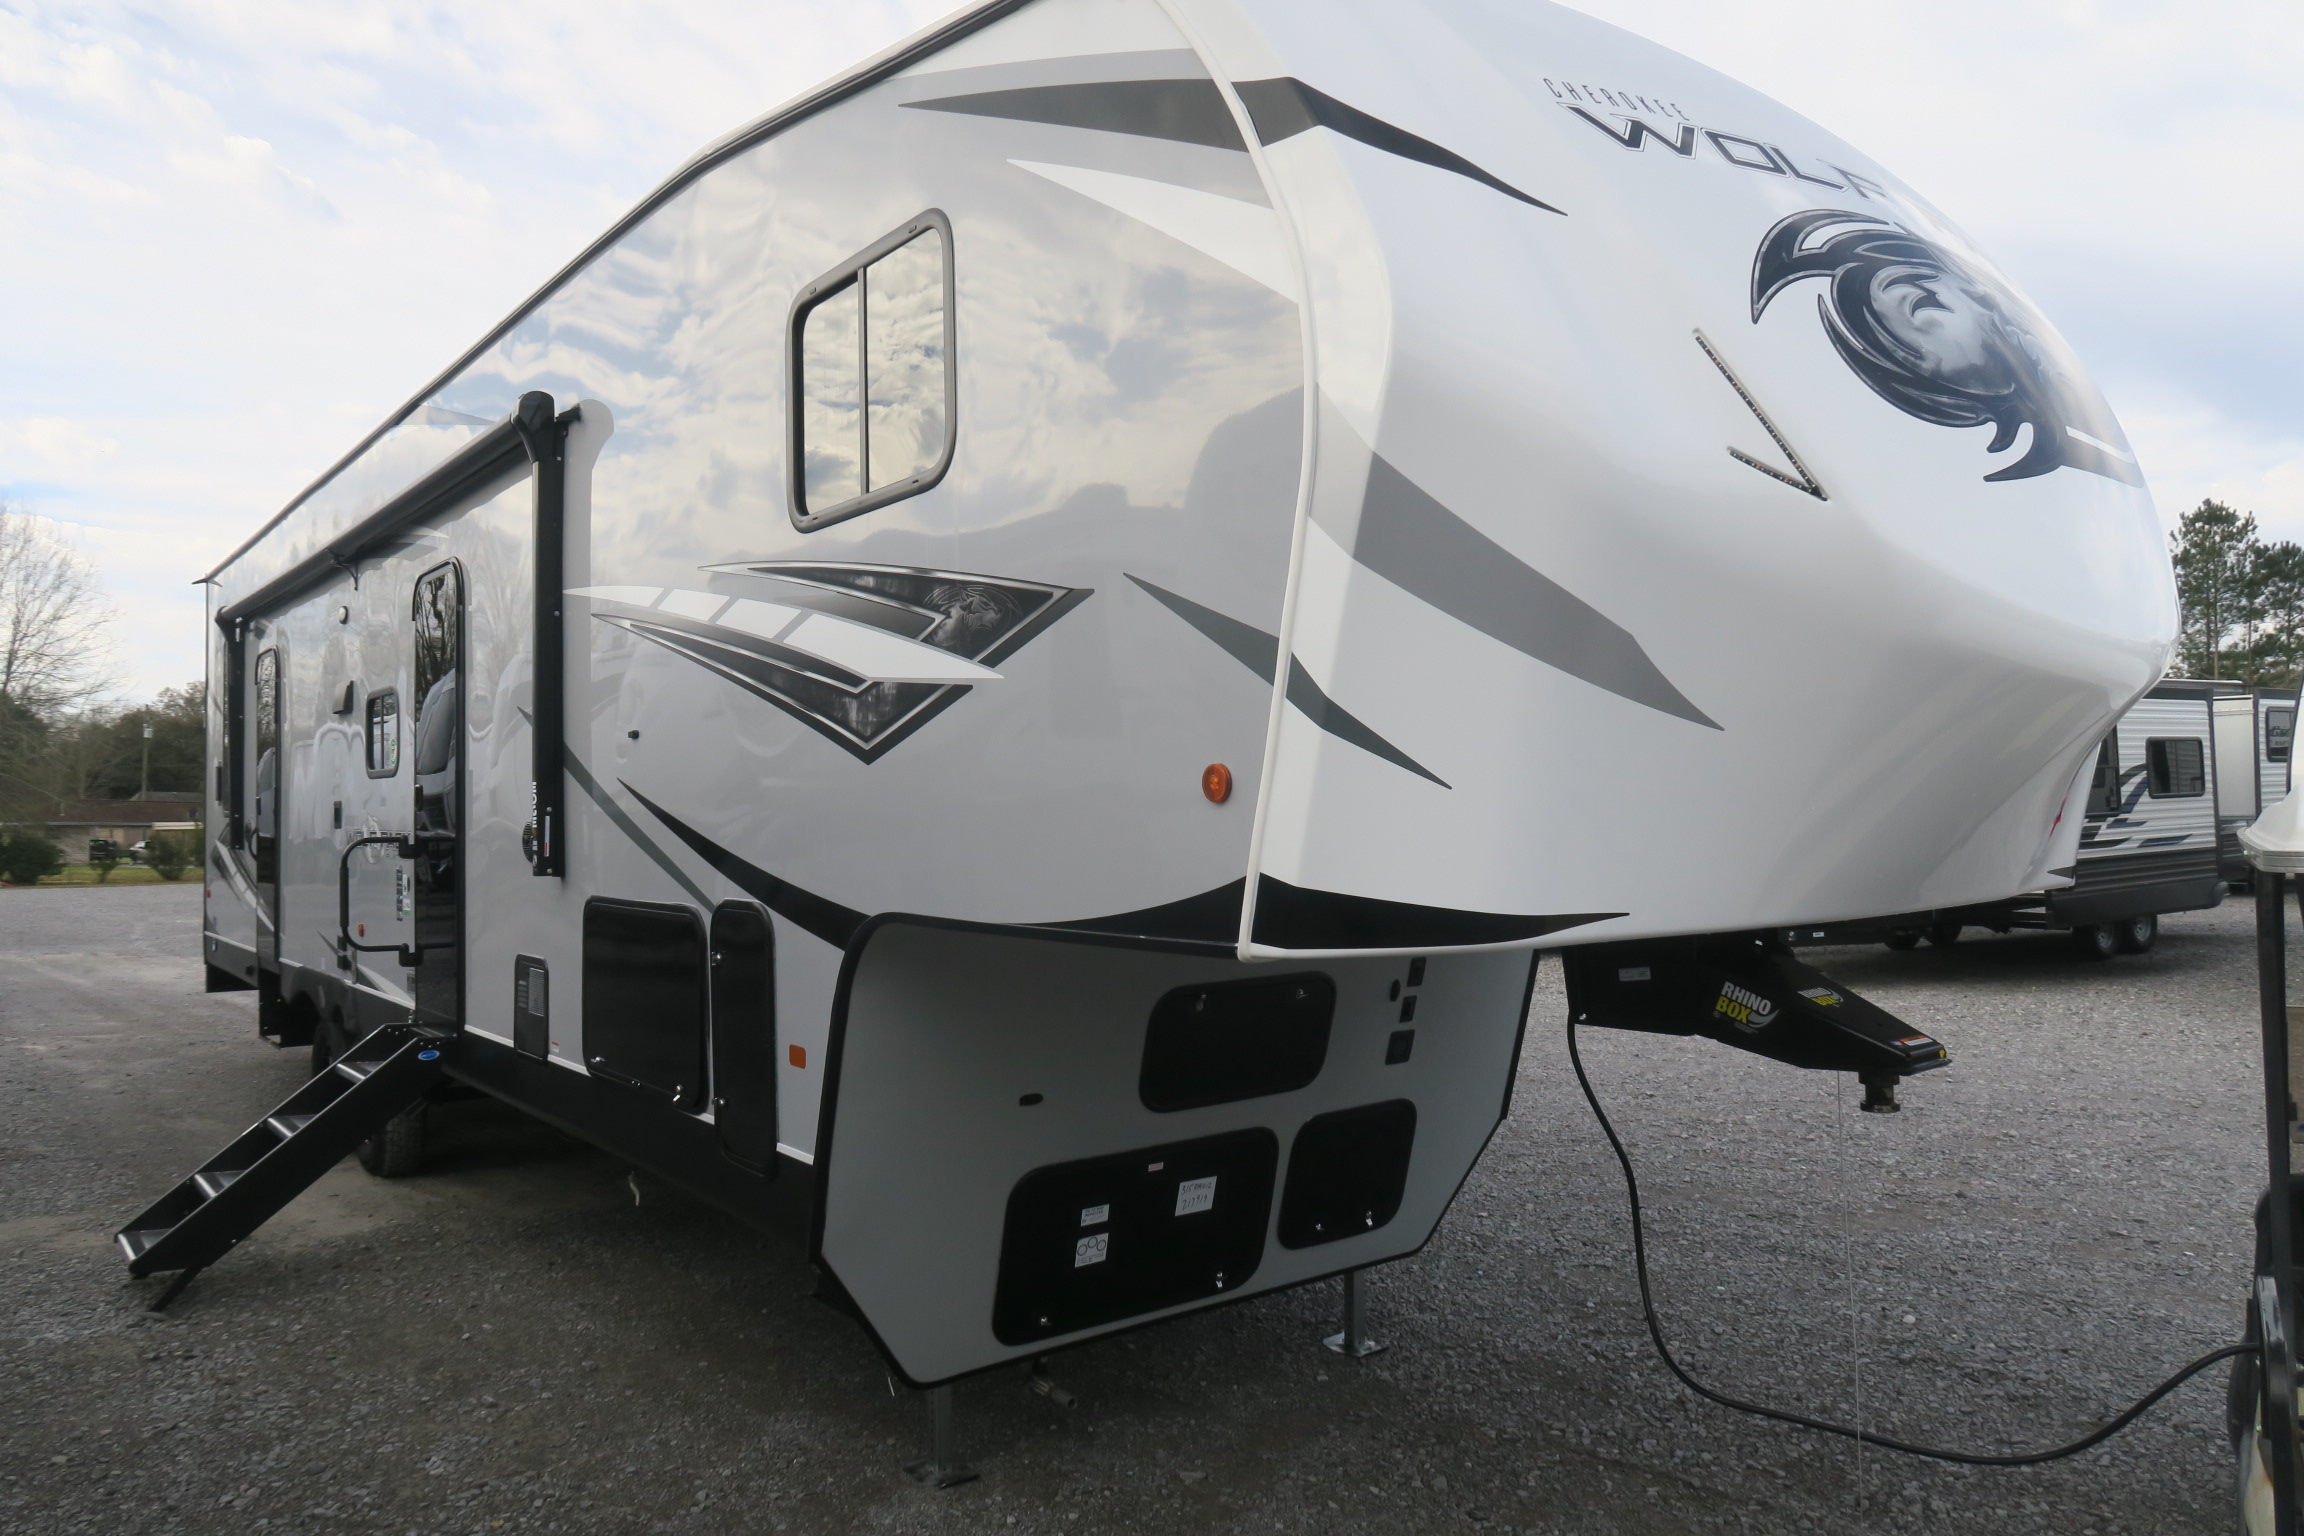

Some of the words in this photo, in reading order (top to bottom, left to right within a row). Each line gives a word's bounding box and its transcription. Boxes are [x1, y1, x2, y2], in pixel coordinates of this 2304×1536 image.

[1542, 78, 1690, 121] CHEROKEE
[1556, 102, 1888, 202] WOLF
[1715, 995, 1753, 1024] BOX
[1721, 980, 1771, 1015] RHINO
